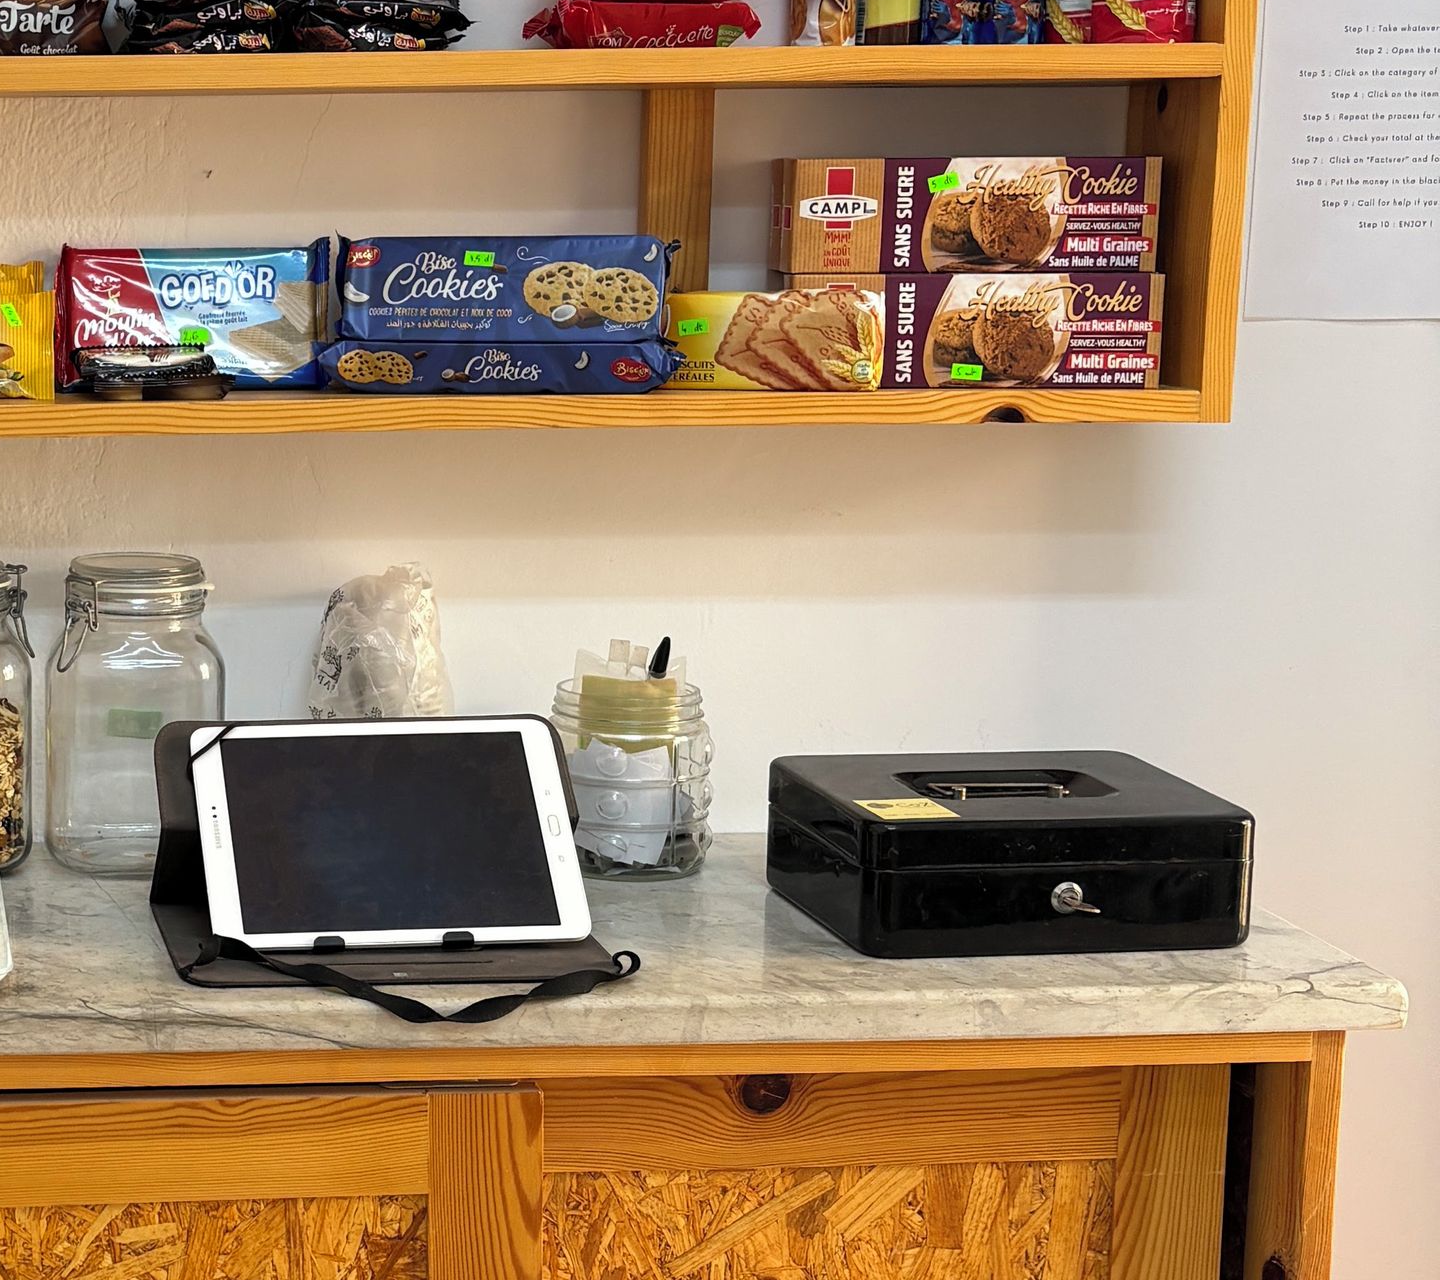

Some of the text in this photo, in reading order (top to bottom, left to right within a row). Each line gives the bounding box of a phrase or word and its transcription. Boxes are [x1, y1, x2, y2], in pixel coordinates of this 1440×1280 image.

[1378, 24, 1398, 32] Take
[1400, 24, 1440, 32] whatever
[598, 36, 622, 48] TOM
[20, 44, 78, 55] Goût chocolat
[1392, 47, 1414, 55] Open
[1299, 70, 1318, 78] Step
[1372, 68, 1385, 76] the
[1429, 67, 1438, 75] of
[1368, 90, 1388, 98] Click
[1404, 90, 1418, 98] the
[1420, 90, 1439, 98] item
[1303, 113, 1322, 122] Step
[1339, 113, 1369, 122] Repeat
[1372, 112, 1385, 120] the
[1422, 111, 1435, 119] for
[1306, 135, 1325, 143] Step
[1342, 134, 1368, 142] Check
[1291, 157, 1310, 166] Step
[1329, 156, 1350, 164] Click
[1330, 178, 1344, 186] Put
[1402, 177, 1416, 185] the
[958, 163, 1138, 212] Healthy Cookie
[1322, 200, 1340, 208] Step
[1393, 198, 1411, 207] help
[894, 166, 915, 268] SANS SUCRE
[1066, 222, 1141, 230] SERVEZ-VOUS HEALTHY
[1359, 221, 1377, 229] Step
[1399, 220, 1427, 228] ENJOY
[825, 232, 851, 243] MMM!
[1067, 237, 1149, 252] Multi Graines
[415, 251, 457, 274] Bisc
[1048, 256, 1138, 267] Sans Huile de PALME
[382, 262, 503, 305] Cookies
[960, 280, 1143, 328] Healthy Cookie
[420, 308, 512, 317] DE CHOCOLAT ET COCO
[895, 282, 916, 382] SANS SUCRE
[1070, 338, 1146, 347] SERVEZ-VOUS HEALTHY
[483, 349, 511, 363] Bisc
[1071, 354, 1154, 369] Multi Graines
[464, 359, 542, 383] Cookies
[1052, 372, 1143, 384] Sans Huile de PALME
